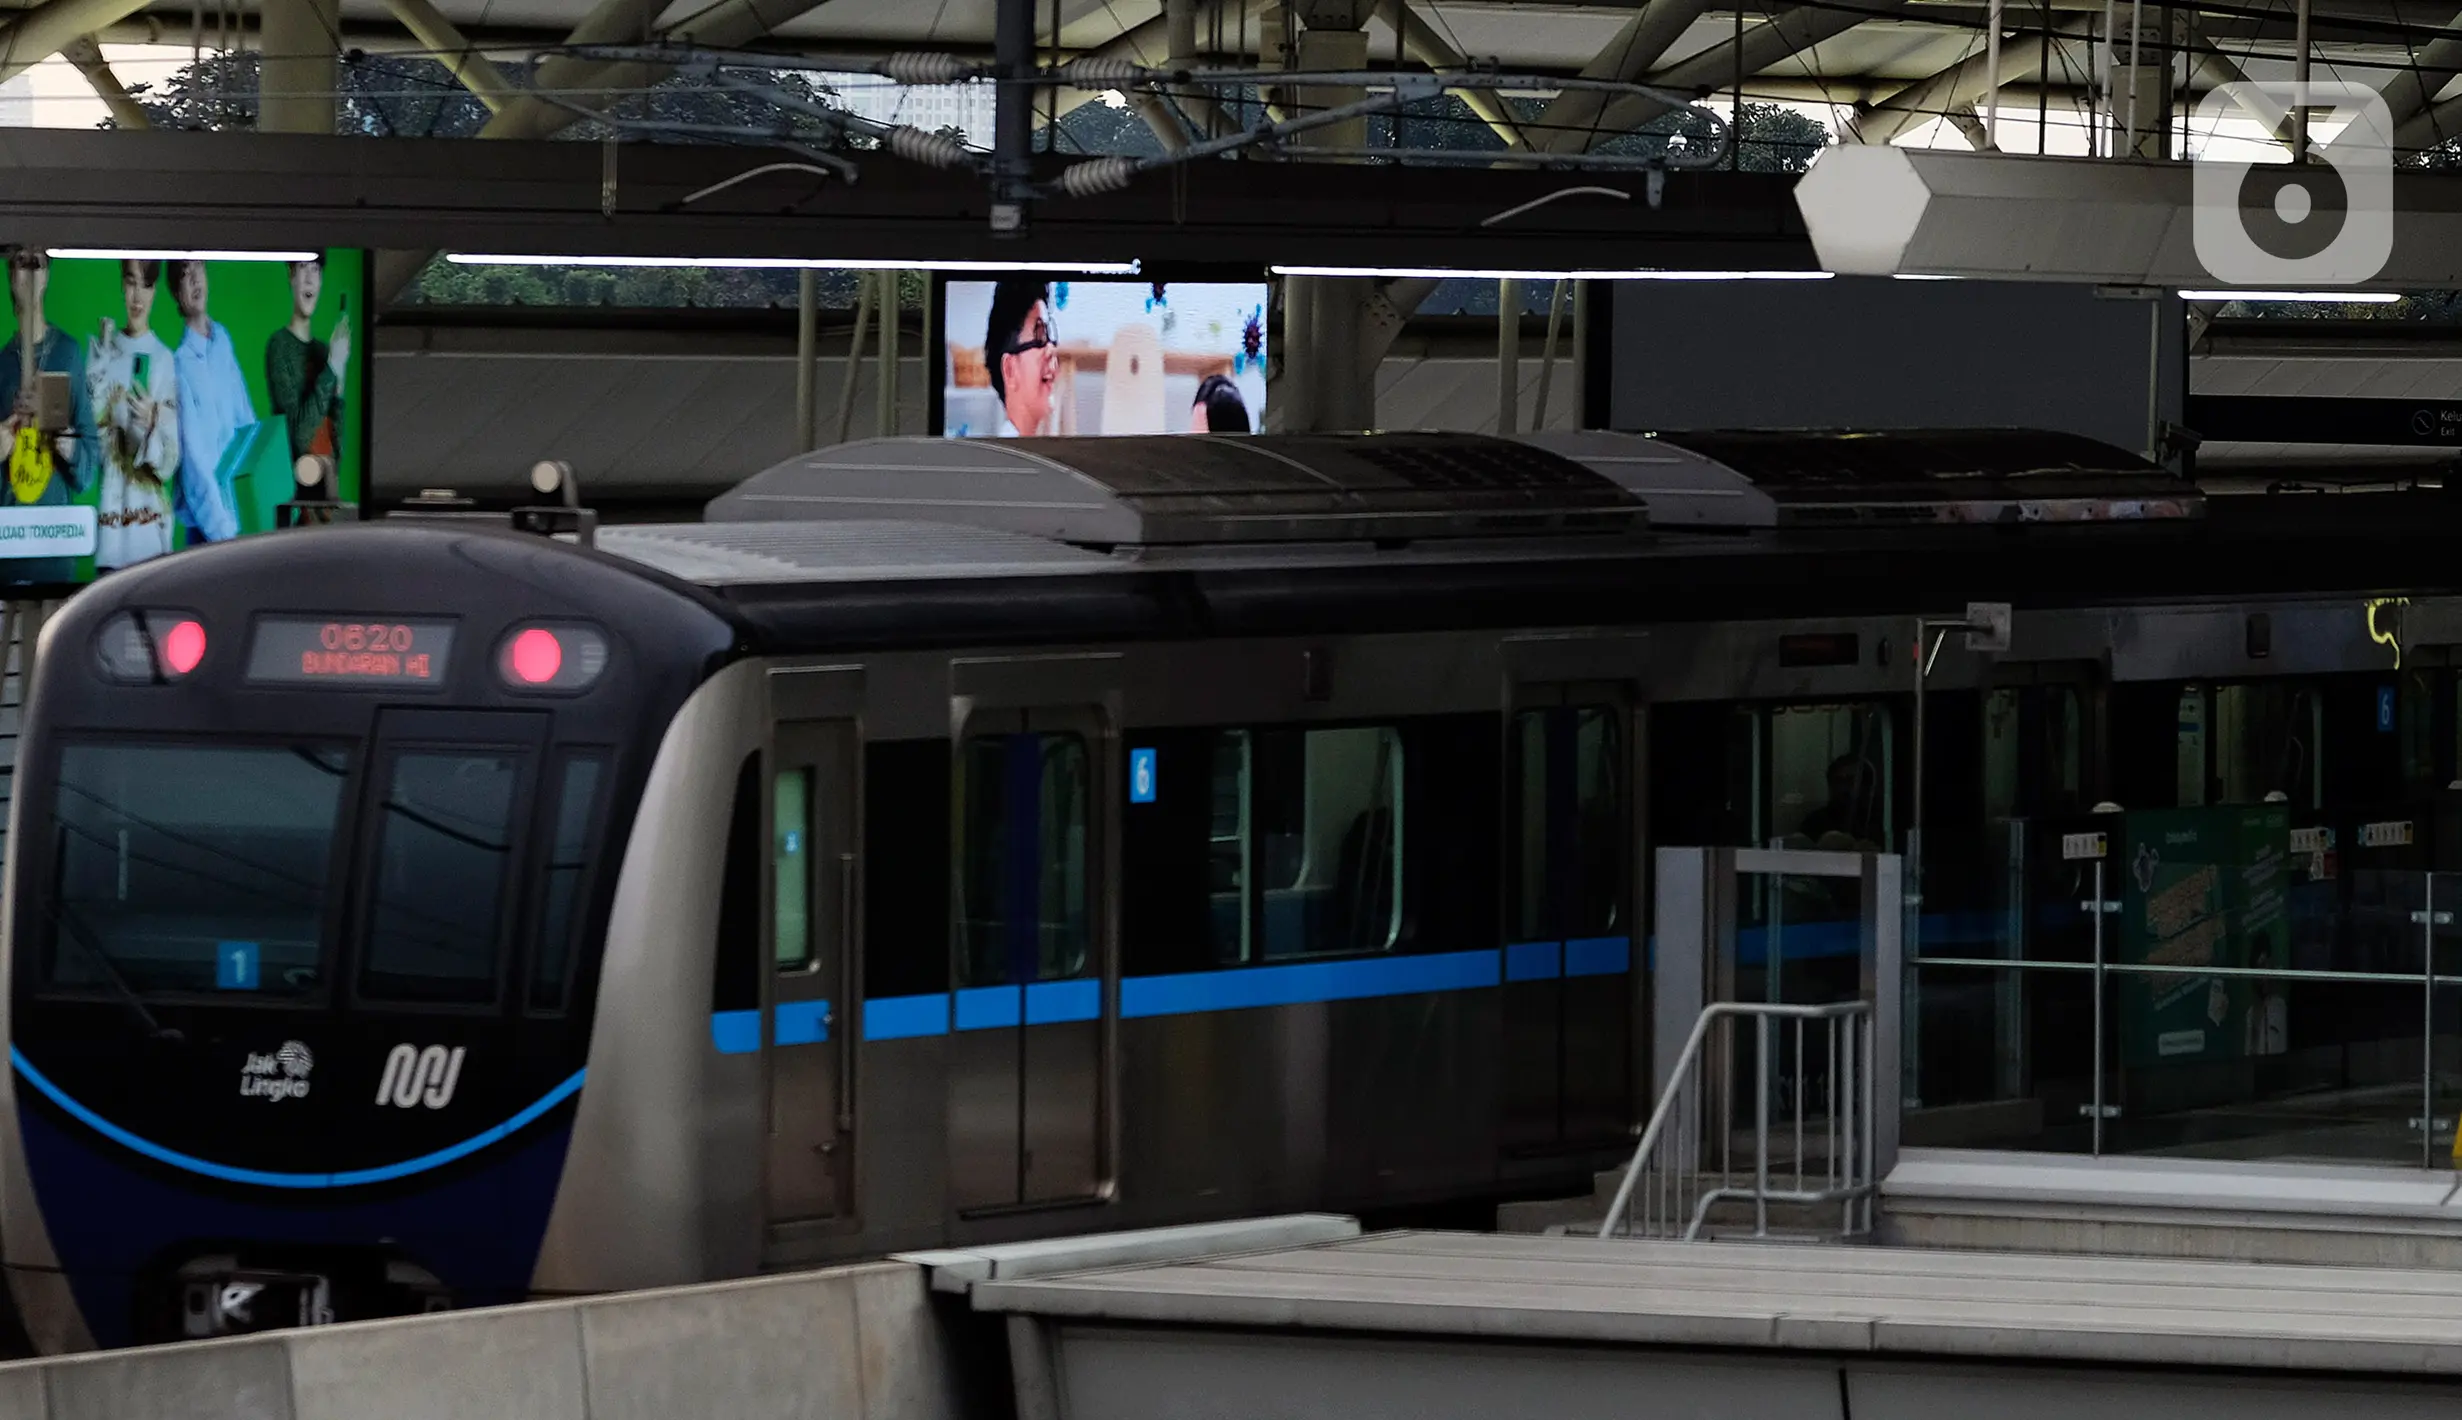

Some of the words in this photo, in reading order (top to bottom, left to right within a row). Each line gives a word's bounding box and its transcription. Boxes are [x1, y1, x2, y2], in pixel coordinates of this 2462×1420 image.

[2441, 427, 2455, 437] Exit
[29, 523, 85, 539] TOKOPEDIA
[320, 624, 413, 651] 0620
[2381, 692, 2391, 726] 6
[1136, 755, 1150, 796] 6
[231, 949, 248, 984] 1
[241, 1051, 279, 1075] Jak
[240, 1074, 310, 1102] Lingko
